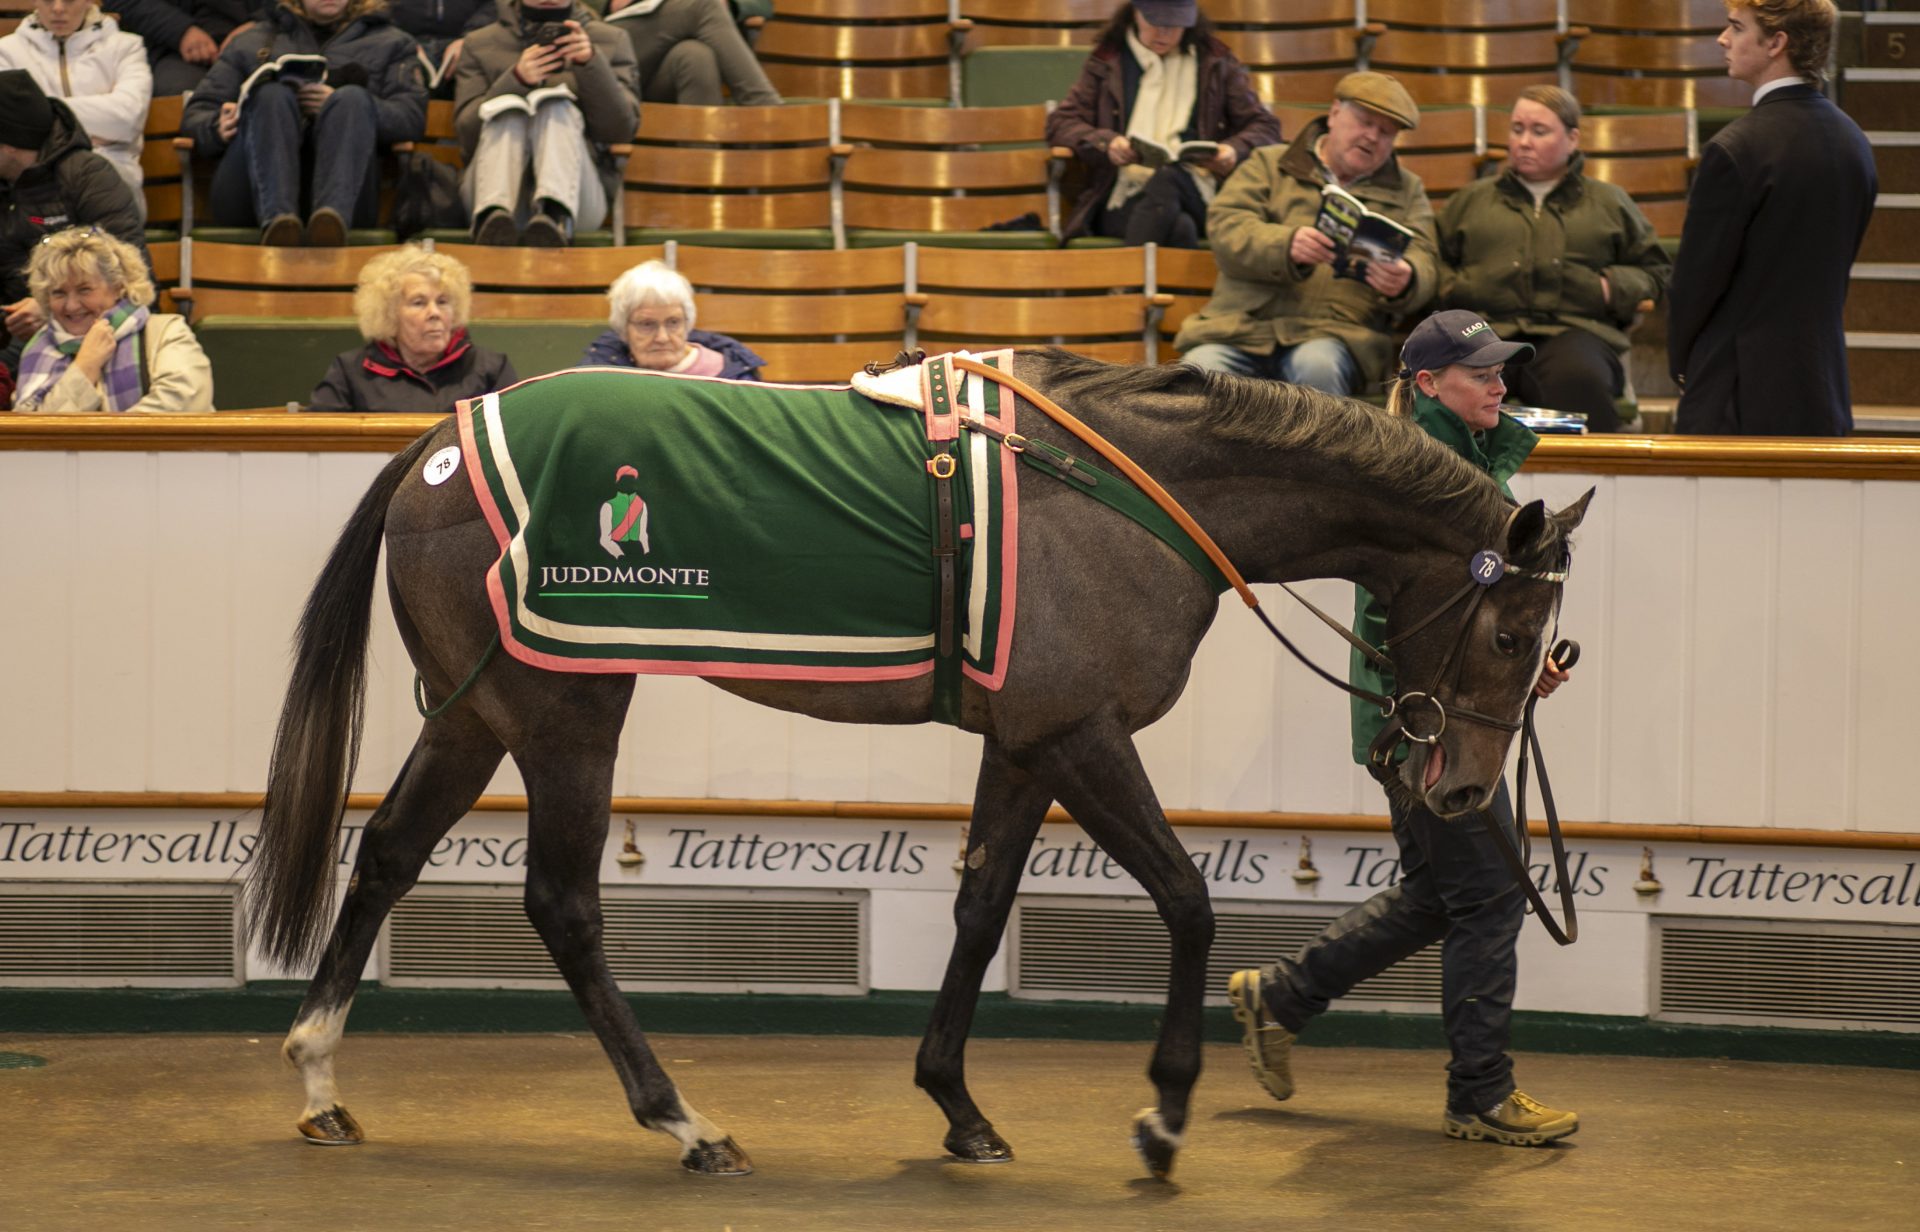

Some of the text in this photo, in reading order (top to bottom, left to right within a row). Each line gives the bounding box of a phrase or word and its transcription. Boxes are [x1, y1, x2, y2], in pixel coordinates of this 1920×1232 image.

[1887, 32, 1906, 60] 5
[1461, 321, 1483, 337] LEAD
[436, 457, 451, 475] 78
[540, 566, 709, 588] JUDDMONTE
[1478, 557, 1496, 578] 78
[0, 820, 257, 865] Tattersalls
[668, 828, 928, 876] Tattersalls
[1021, 837, 1269, 884] attealls
[1686, 856, 1920, 907] Tattersal
